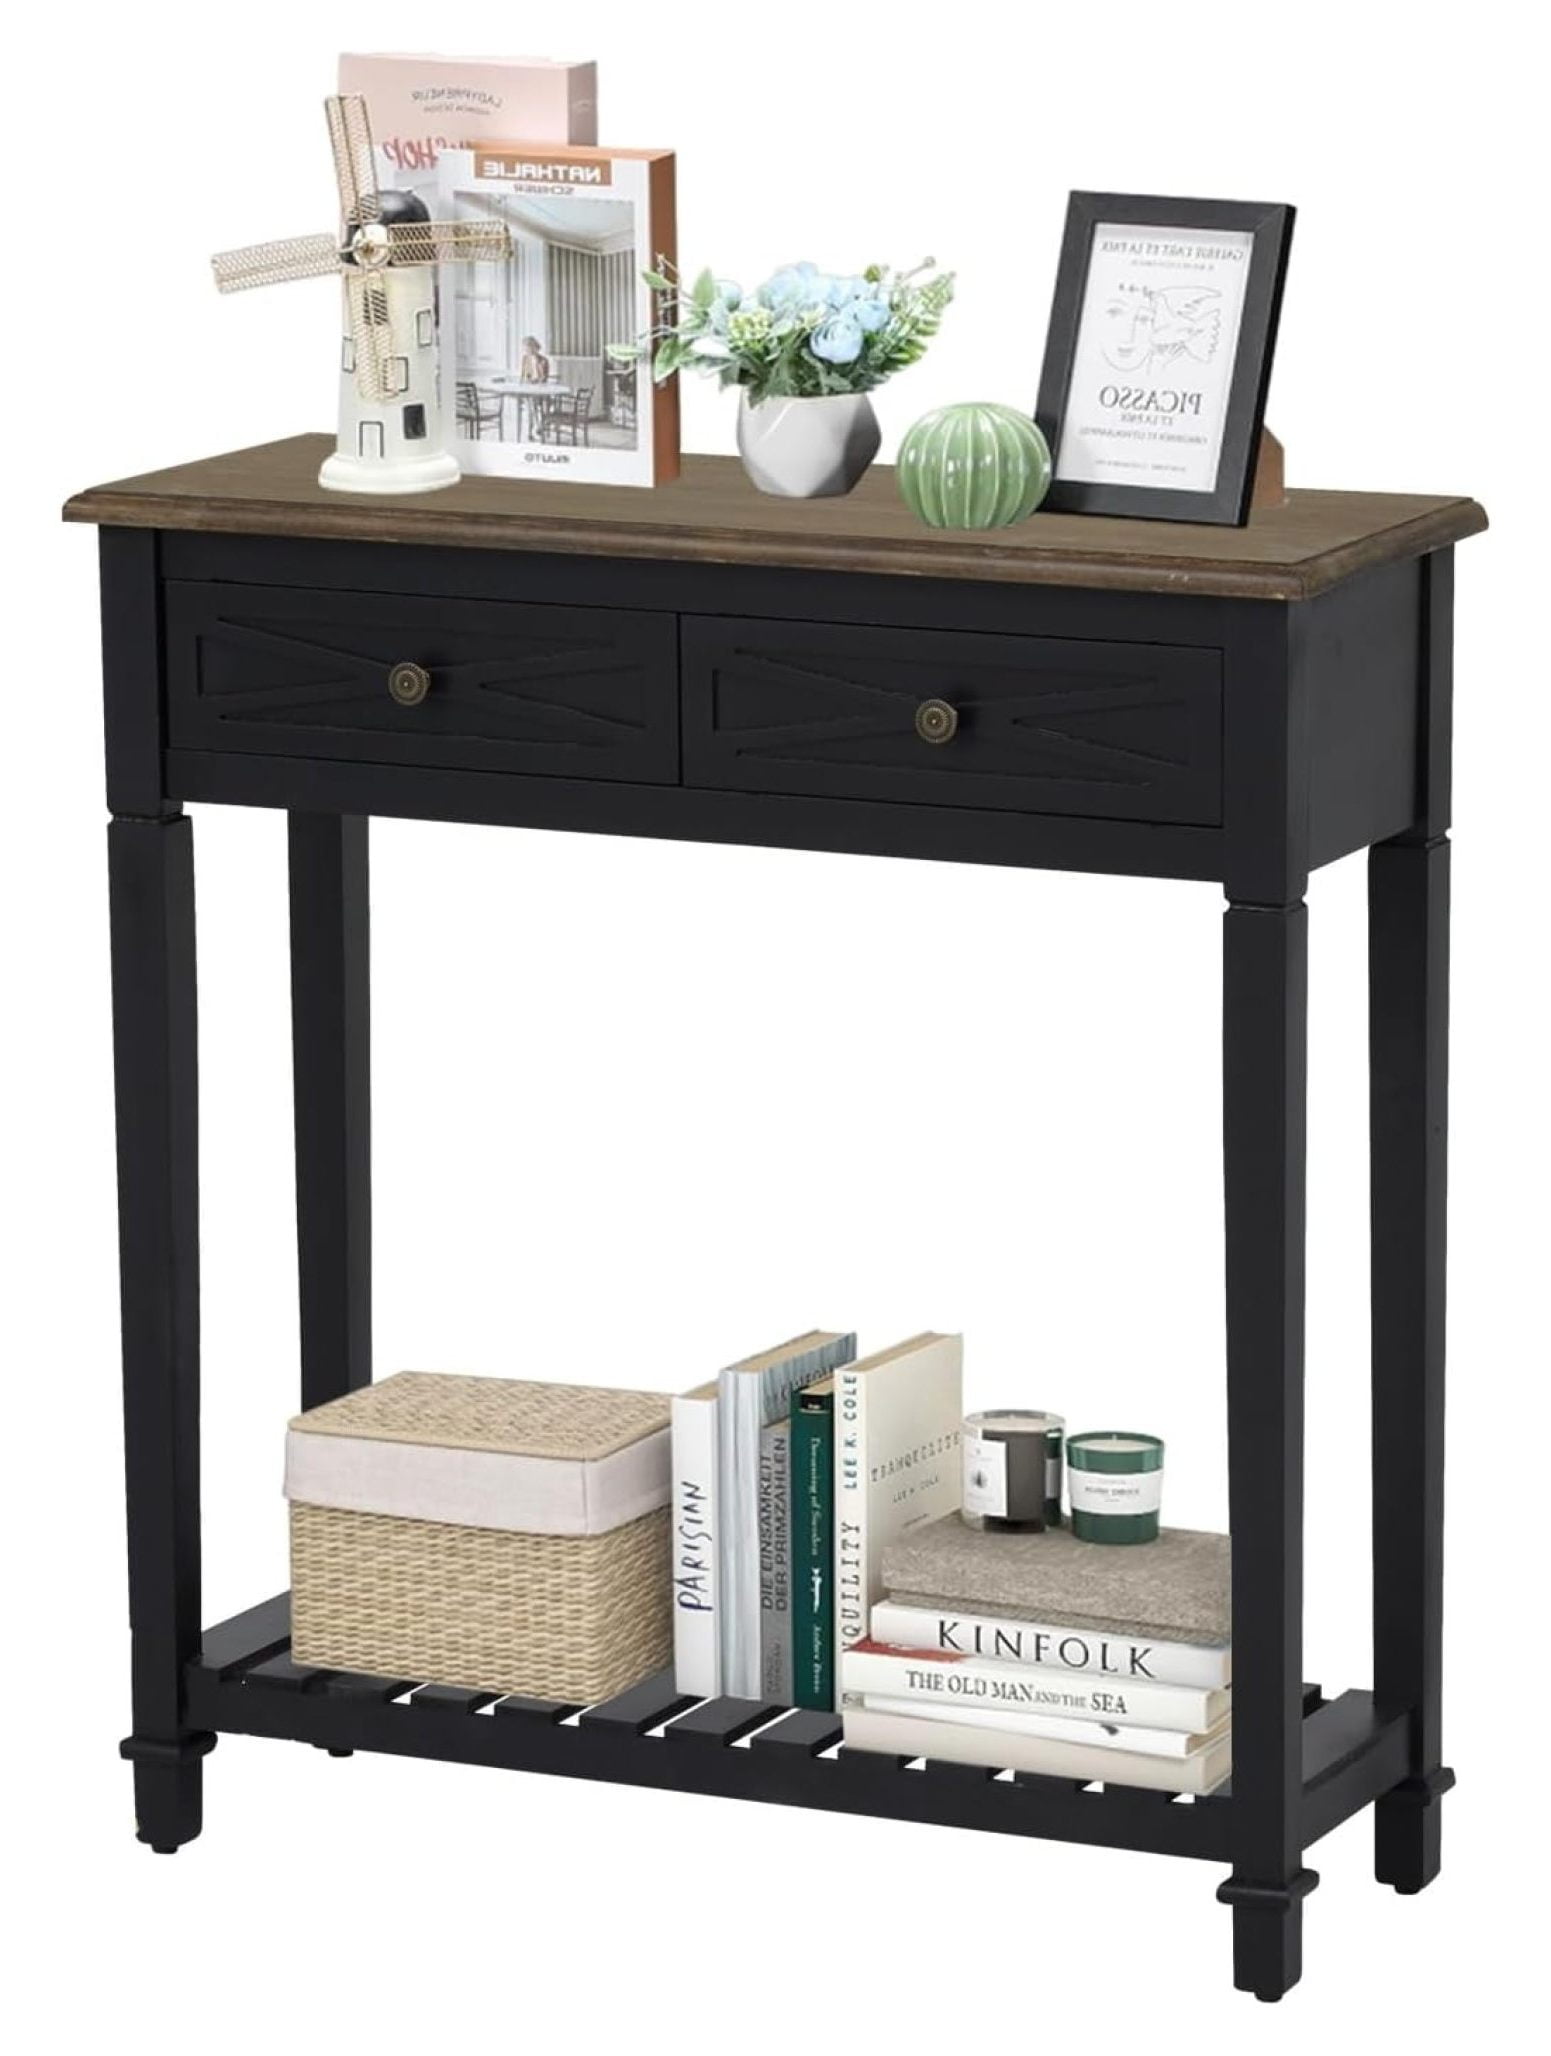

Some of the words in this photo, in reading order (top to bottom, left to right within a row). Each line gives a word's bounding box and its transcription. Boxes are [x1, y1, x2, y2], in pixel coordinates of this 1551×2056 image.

[842, 1375, 858, 1422] COLE
[843, 1457, 858, 1489] LEE
[759, 1455, 773, 1572] EINSAMKEIT
[774, 1437, 788, 1565] PRIMZAHLEN
[674, 1481, 714, 1612] PARISIAN
[760, 1577, 774, 1611] DIE
[774, 1572, 788, 1612] DER
[938, 1619, 1158, 1679] KINFOLK
[906, 1670, 944, 1692] THE
[948, 1674, 988, 1697] OLD
[991, 1680, 1034, 1702] MAN
[1090, 1692, 1129, 1714] SEA
